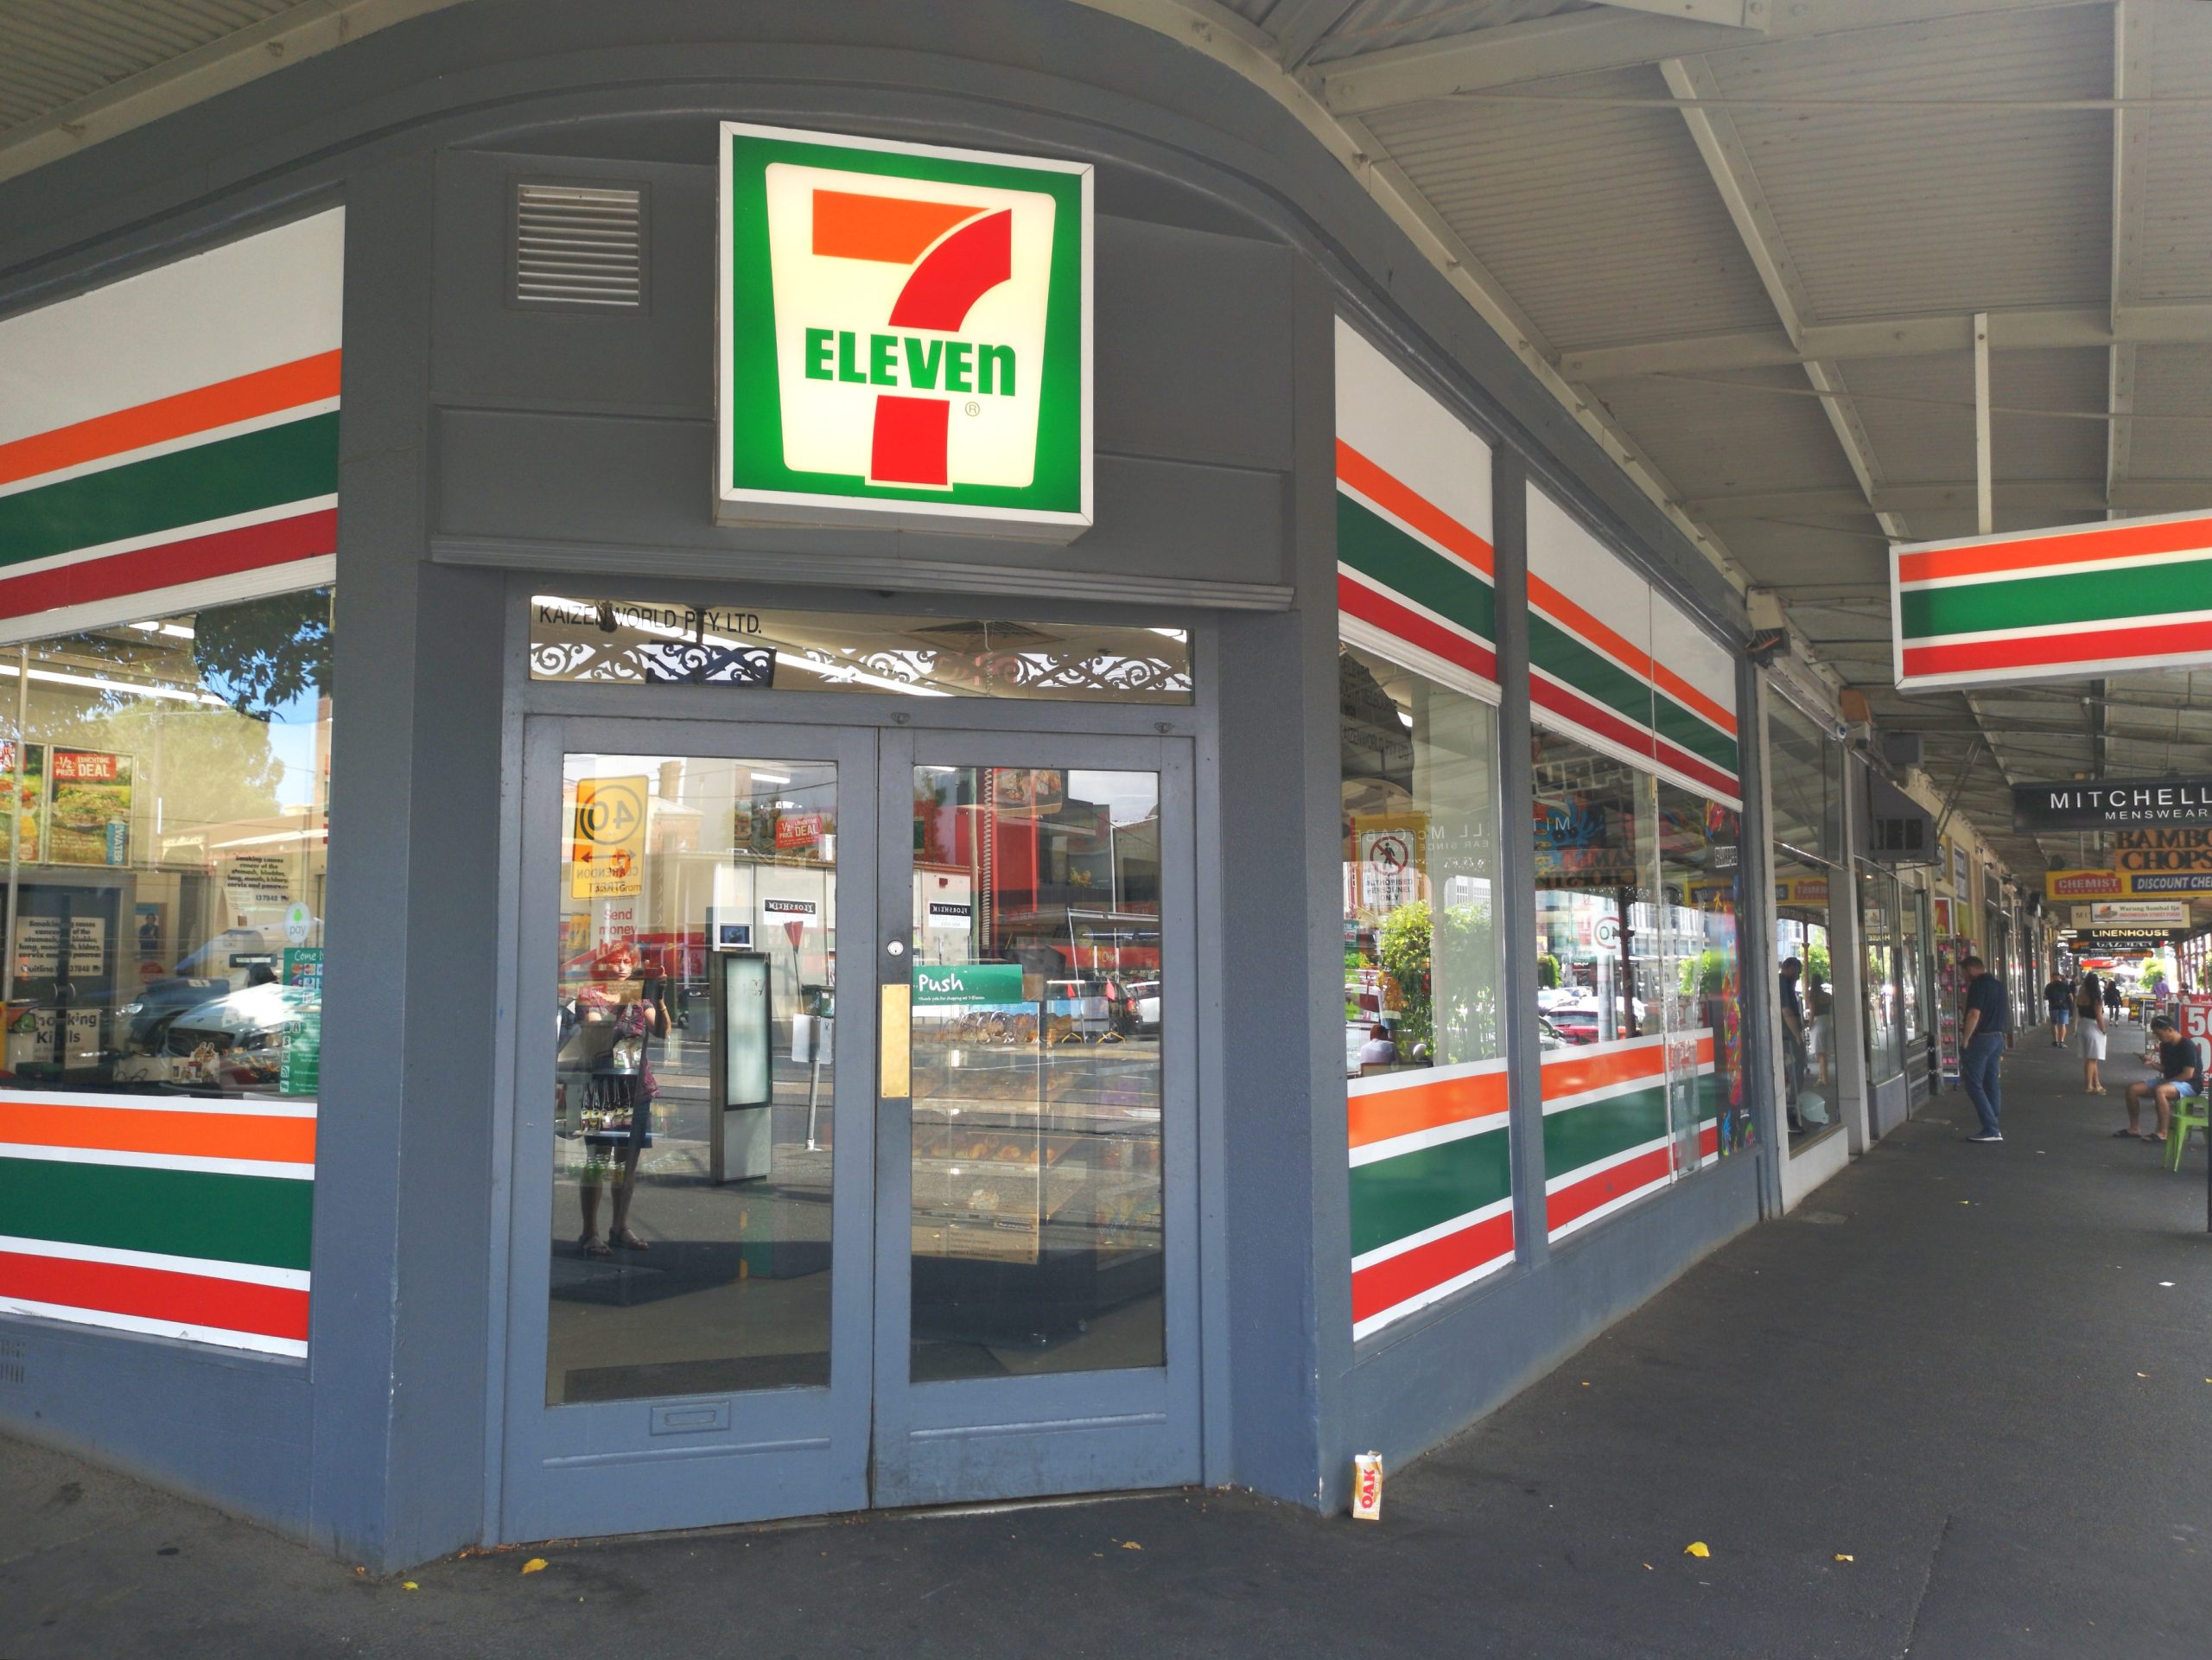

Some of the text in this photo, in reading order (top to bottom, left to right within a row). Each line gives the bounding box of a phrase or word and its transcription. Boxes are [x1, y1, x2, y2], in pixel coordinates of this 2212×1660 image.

[684, 610, 720, 632] PY.
[727, 613, 762, 633] LTD.
[79, 764, 111, 777] DEAL
[2050, 786, 2212, 810] MITCHELL
[2105, 808, 2209, 820] MENSWEAR
[795, 824, 820, 837] DEAL
[2058, 878, 2119, 888] CHEMIST
[2138, 877, 2189, 889] DISCOUNT
[604, 908, 633, 920] Send
[289, 925, 306, 936] pay
[599, 925, 638, 936] money
[294, 950, 317, 961] Come
[918, 973, 964, 992] Push
[1361, 1469, 1376, 1509] OAK
